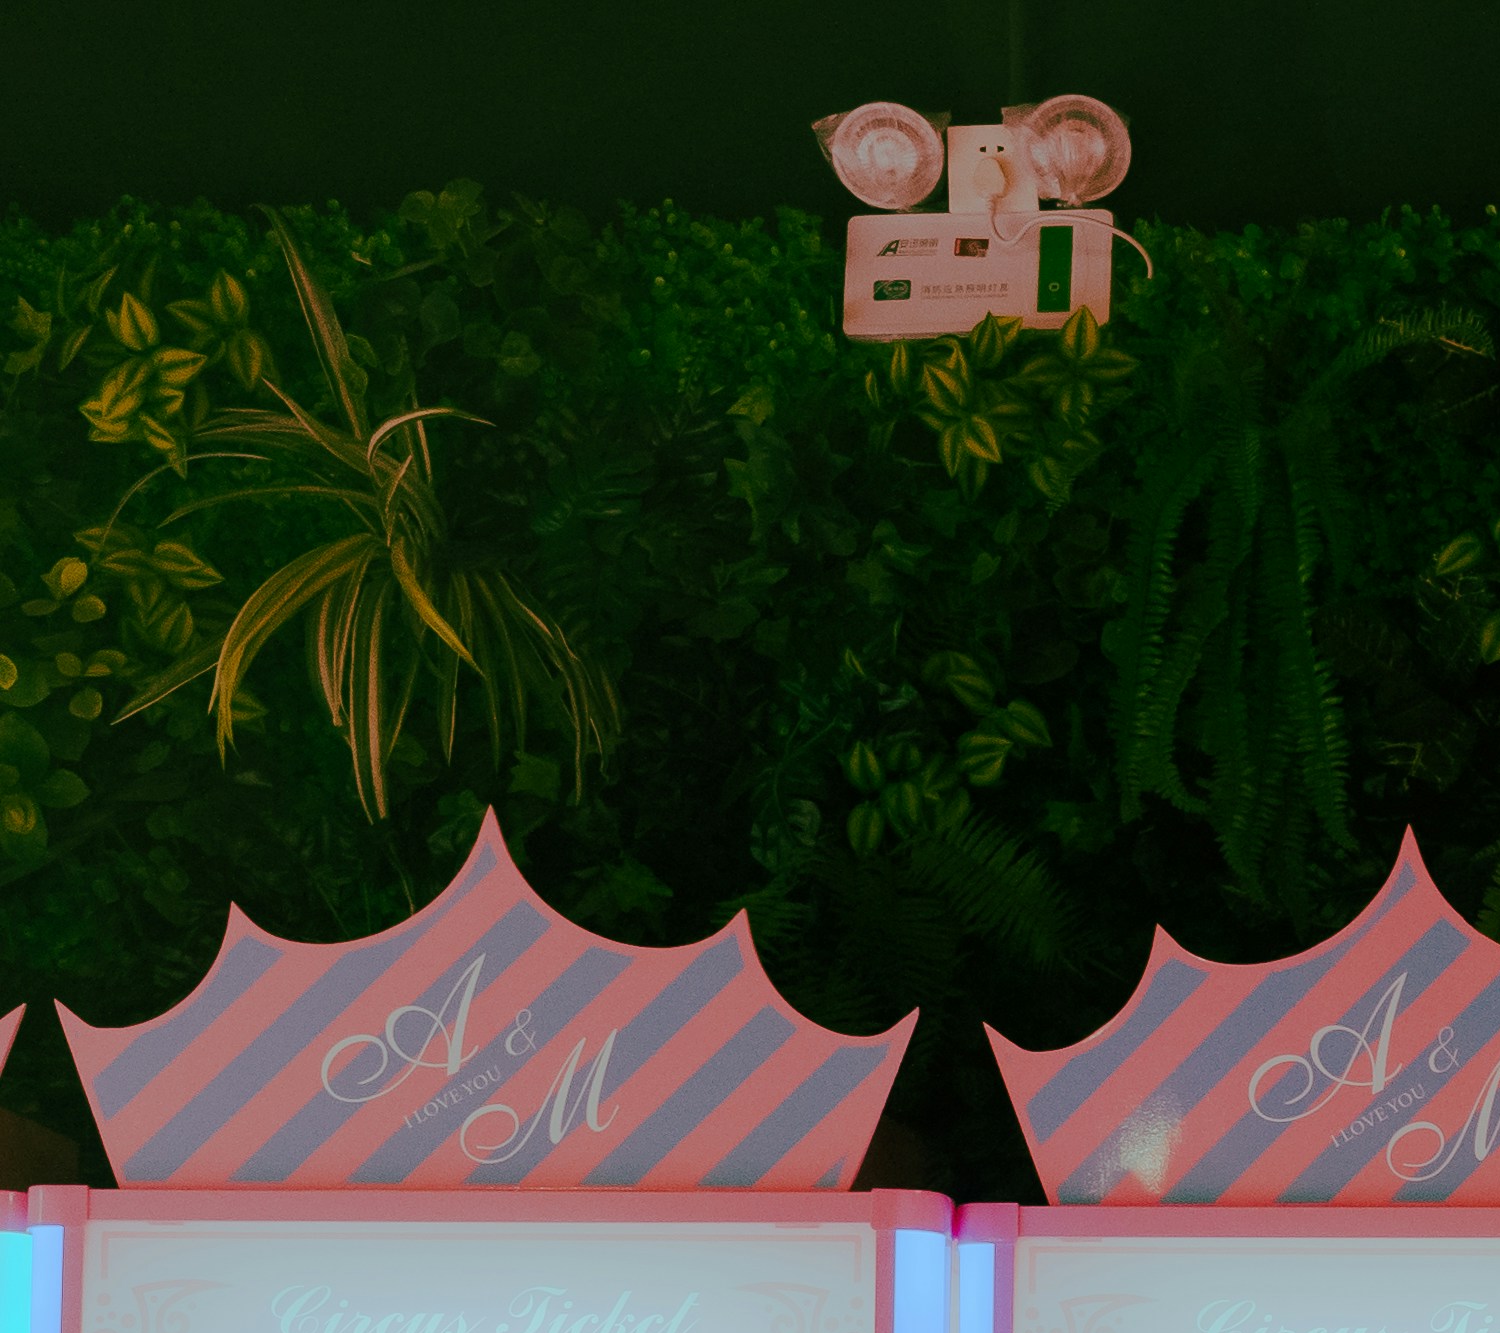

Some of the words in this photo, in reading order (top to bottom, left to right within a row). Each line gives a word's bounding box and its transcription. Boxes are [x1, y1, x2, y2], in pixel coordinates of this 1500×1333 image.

[321, 953, 486, 1102] A
[505, 1008, 537, 1056] &
[1248, 972, 1408, 1123] A
[1428, 1026, 1460, 1074] &
[403, 1115, 414, 1130] I
[411, 1086, 464, 1125] LOVE
[462, 1064, 501, 1098] YOU
[460, 1028, 619, 1165] M
[1330, 1133, 1341, 1149] I
[1339, 1106, 1390, 1143] LOVE
[1386, 1083, 1427, 1117] YOU
